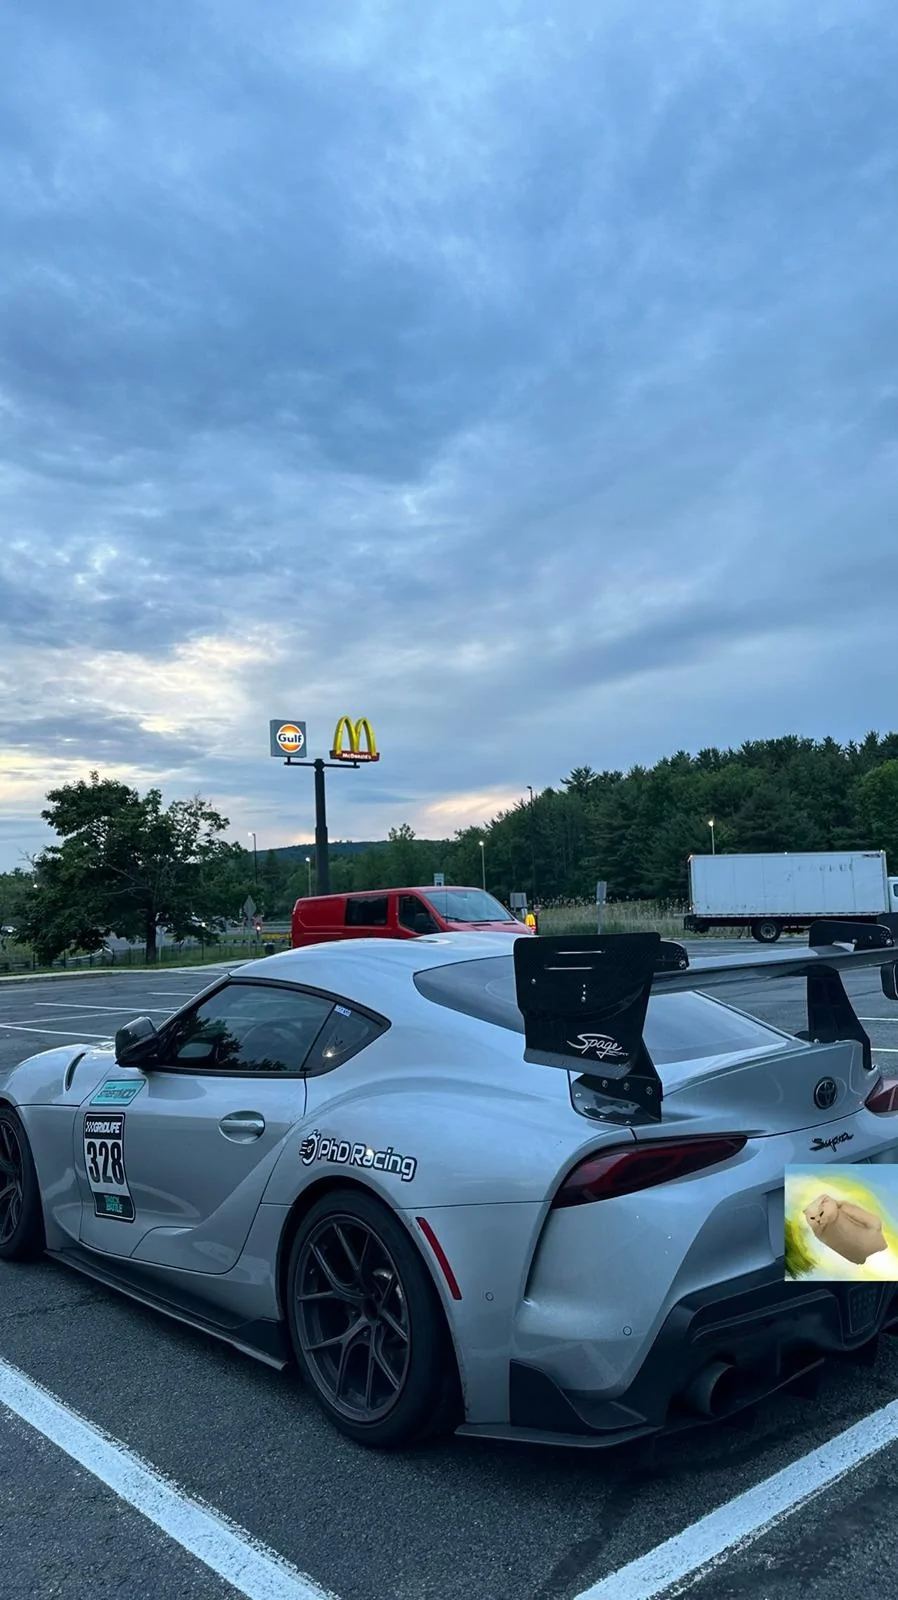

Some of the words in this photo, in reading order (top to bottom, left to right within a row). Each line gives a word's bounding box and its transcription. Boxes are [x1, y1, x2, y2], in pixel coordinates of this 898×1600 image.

[278, 733, 302, 743] Gulf
[342, 752, 372, 760] McDonald's
[566, 1033, 622, 1059] Spage
[94, 1122, 121, 1134] GRIDLIFE
[809, 1132, 854, 1153] Supra
[87, 1141, 124, 1185] 328
[318, 1138, 351, 1163] PhD
[350, 1143, 418, 1182] Racing
